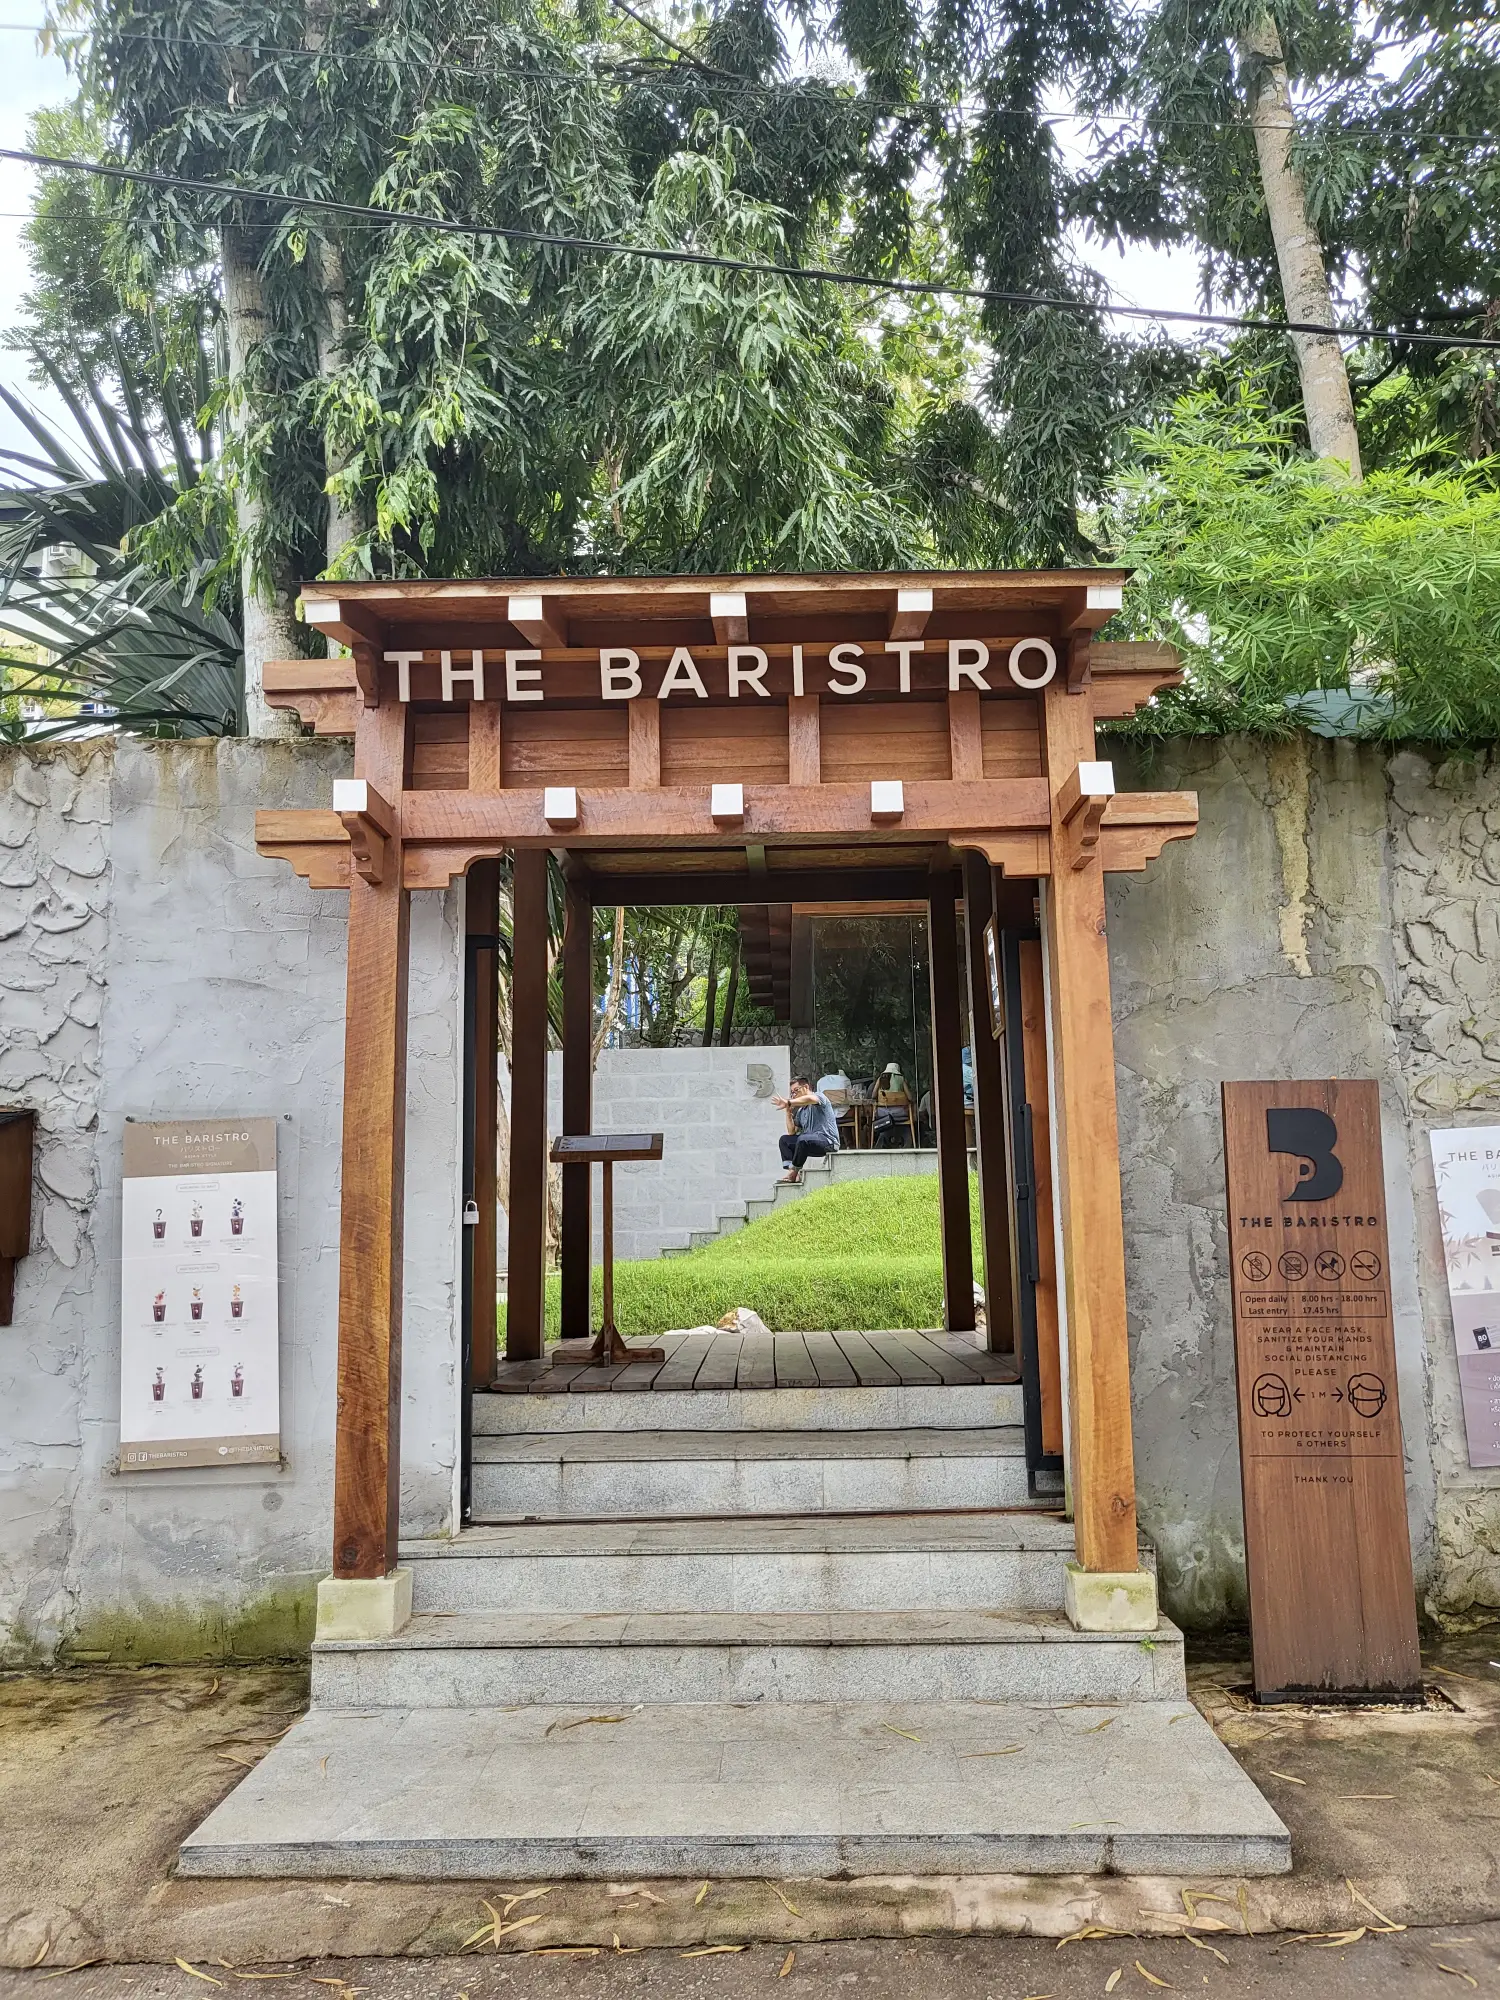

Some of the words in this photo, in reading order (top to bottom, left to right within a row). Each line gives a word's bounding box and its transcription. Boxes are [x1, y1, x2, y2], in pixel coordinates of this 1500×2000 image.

[383, 650, 544, 702] THE
[599, 637, 1057, 700] BARISTRO
[154, 1136, 179, 1145] THE
[185, 1132, 249, 1144] BARISTRO
[1448, 1151, 1478, 1162] THE
[1240, 1217, 1273, 1228] THE
[1283, 1216, 1377, 1228] BARISTRO
[1245, 1295, 1266, 1304] Open
[1268, 1295, 1288, 1304] daily
[1249, 1307, 1265, 1315] Last
[1266, 1307, 1288, 1316] entry
[1294, 1368, 1337, 1376] PLEASE
[148, 1451, 188, 1459] THEBARISTRO
[1333, 1475, 1354, 1483] YOU
